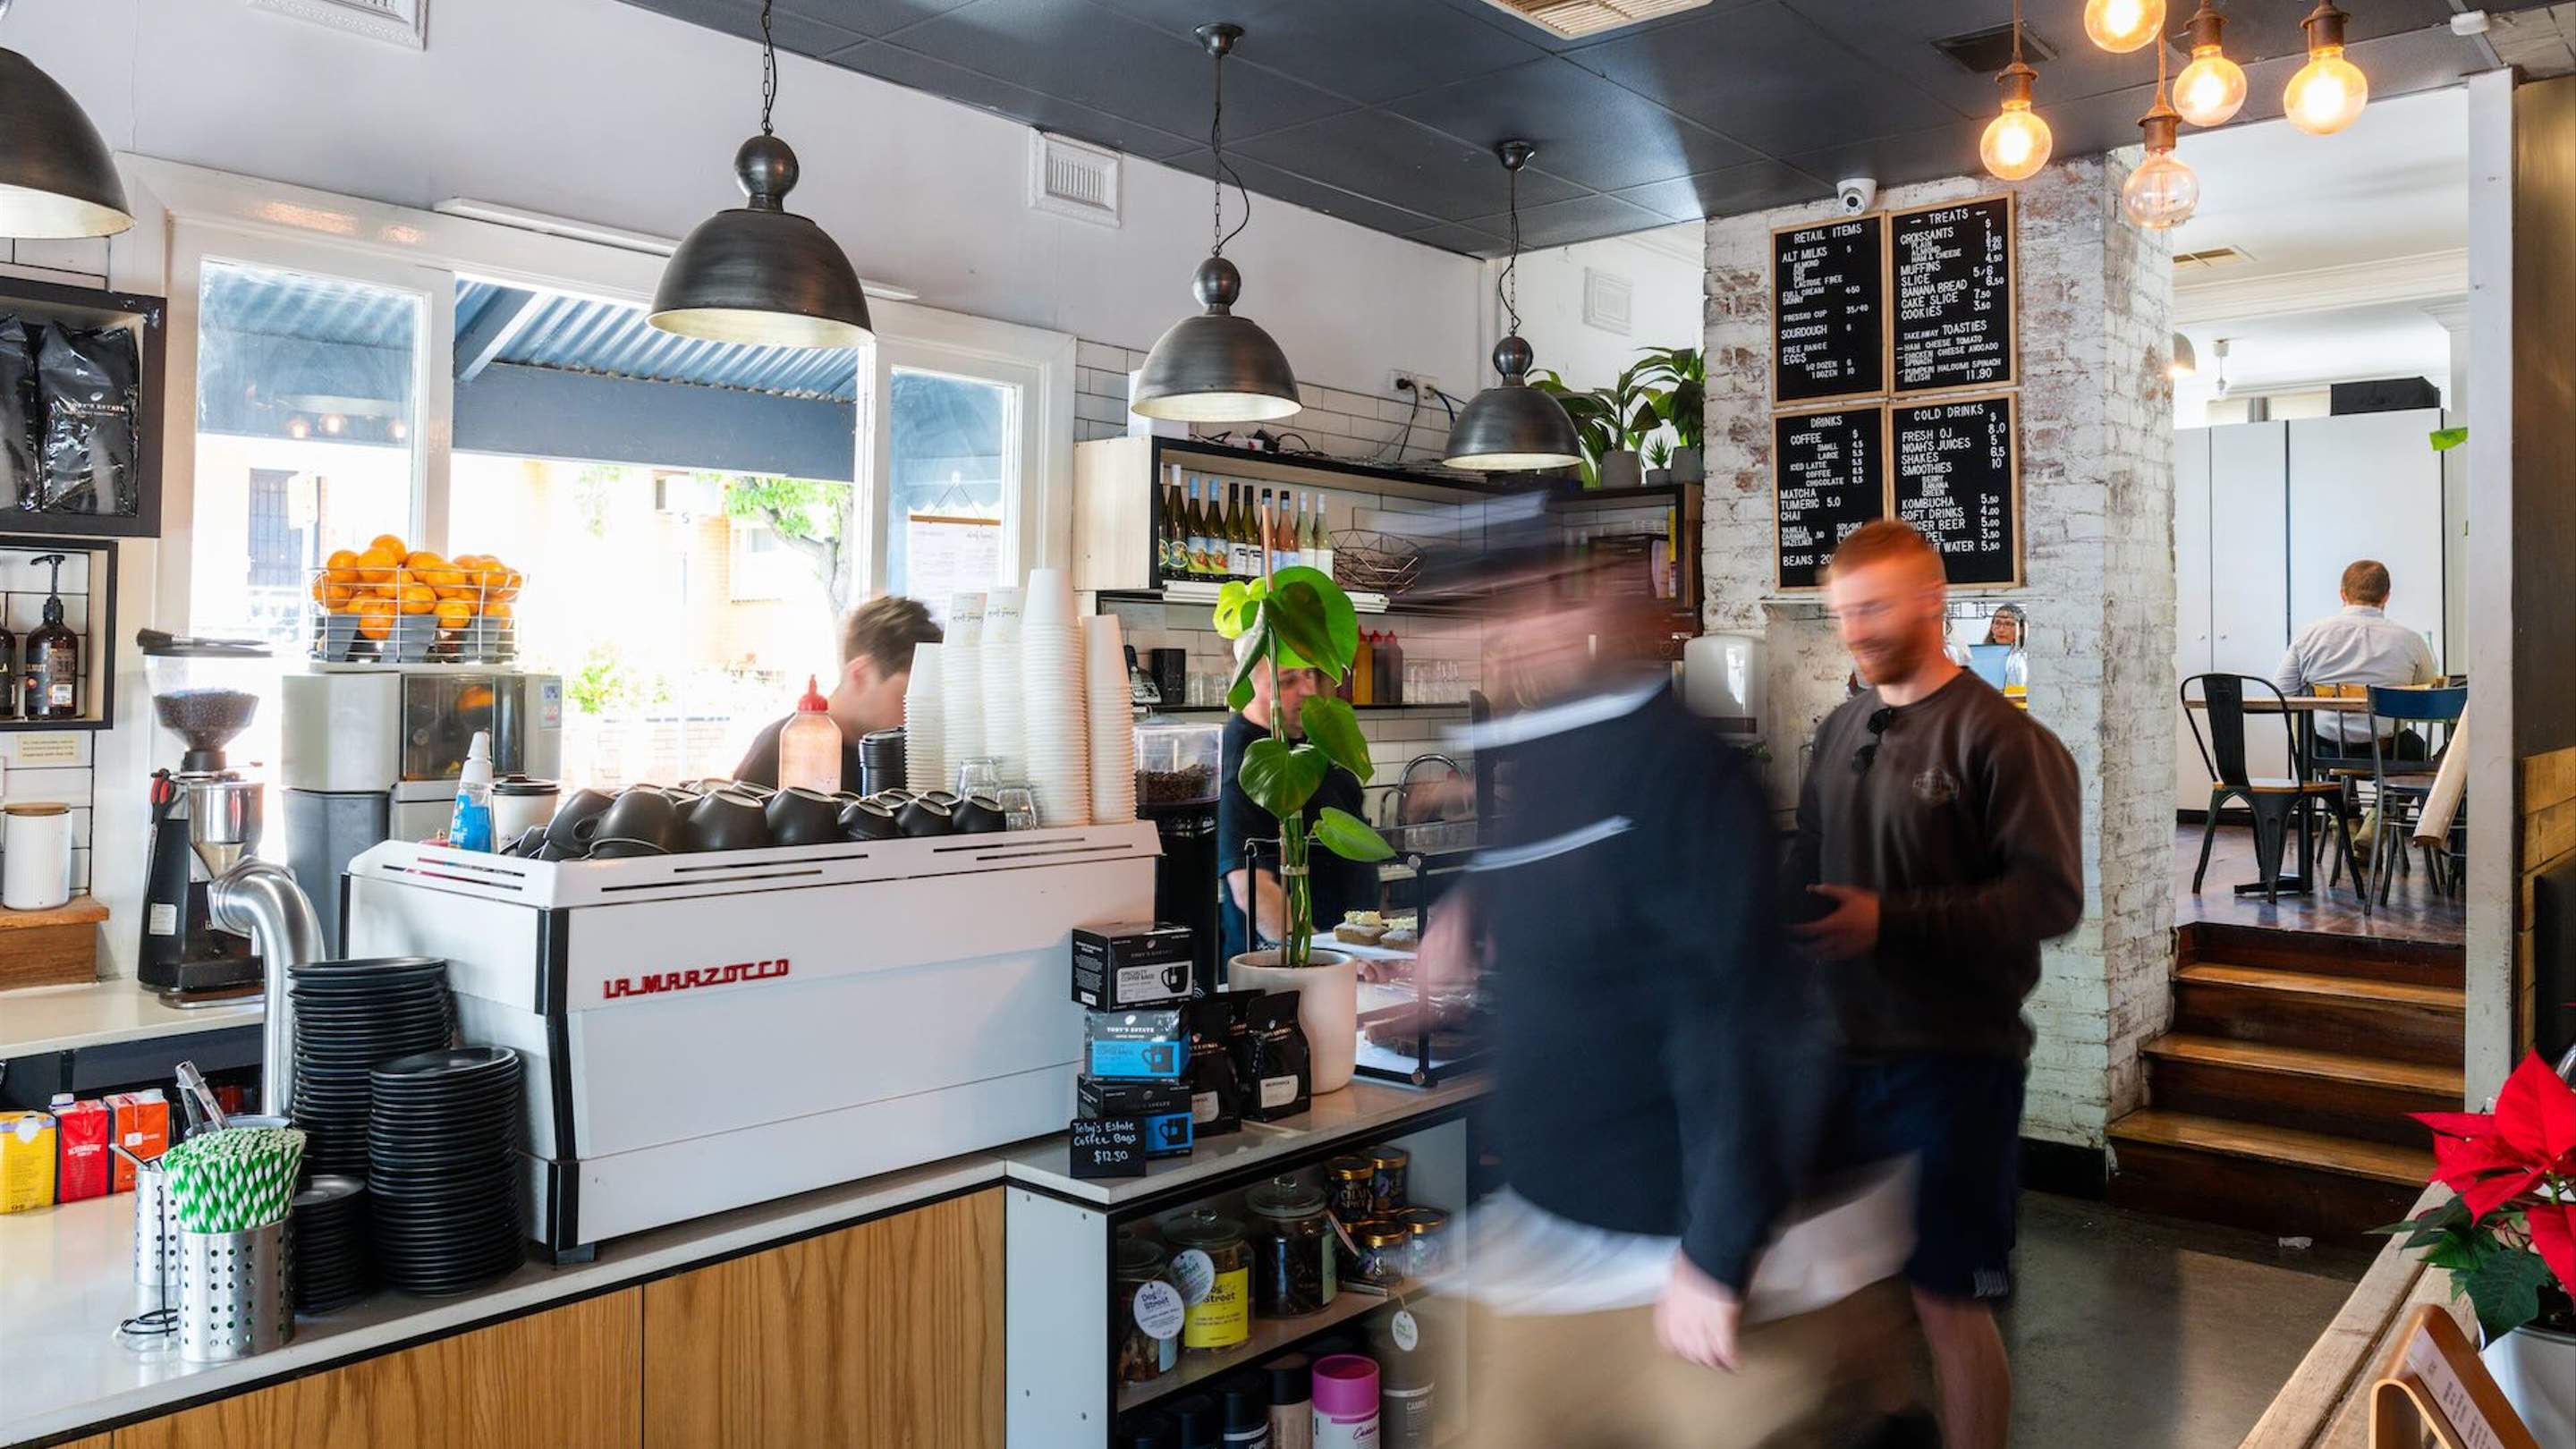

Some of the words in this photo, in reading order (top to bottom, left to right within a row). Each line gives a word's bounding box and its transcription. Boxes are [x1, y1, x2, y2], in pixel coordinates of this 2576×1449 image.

[1928, 208, 1969, 225] TREATS
[1793, 230, 1826, 244] RETAIL
[1832, 224, 1862, 238] ITEMS
[1900, 226, 1954, 245] CROISSANTS
[1782, 250, 1799, 263] ALT
[1801, 247, 1827, 259] MILKS
[1900, 260, 1942, 276] MUFFINS
[1901, 273, 1931, 287] SLICE
[1902, 284, 1936, 298] BANANA
[1936, 278, 1968, 293] BREAD
[1901, 296, 1926, 309] CAKE
[1929, 292, 1959, 305] SLICE
[1901, 305, 1943, 320] COOKIES
[1781, 324, 1827, 340] SOURDOUGH
[1942, 319, 1987, 335] TOASTIES
[1783, 344, 1801, 355] FREE
[1936, 346, 1965, 356] CHEESE
[1968, 342, 1999, 353] AVOCADO
[1914, 408, 1942, 421] COLD
[1947, 403, 1984, 419] DRINKS
[1810, 415, 1843, 428] DRINKS
[1790, 432, 1822, 445] COFFEE
[1902, 429, 1934, 443] FRESH
[1939, 427, 1953, 439] OJ
[1936, 436, 1971, 452] JUICES
[1901, 451, 1939, 465] SHAKES
[1805, 461, 1827, 470] LATTE
[1902, 462, 1953, 477] SMOOTHIES
[1991, 457, 2003, 470] 10
[1780, 487, 1818, 499] MATCHA
[1781, 498, 1820, 510] TUMERIC
[1826, 496, 1842, 508] 5.0
[1902, 496, 1955, 510] KOMBUCHA
[1780, 511, 1801, 521] CHAI
[1901, 509, 1925, 521] SOFT
[1928, 506, 1964, 519] DRINKS
[1938, 518, 1966, 530] BEER
[1943, 539, 1975, 553] WATER
[1783, 555, 1814, 567] BEANS
[1073, 1122, 1102, 1137] Toby's
[1105, 1121, 1135, 1132] Estate
[1073, 1134, 1111, 1147] Coffee
[1114, 1133, 1137, 1145] Bags
[1210, 1284, 1223, 1294] og
